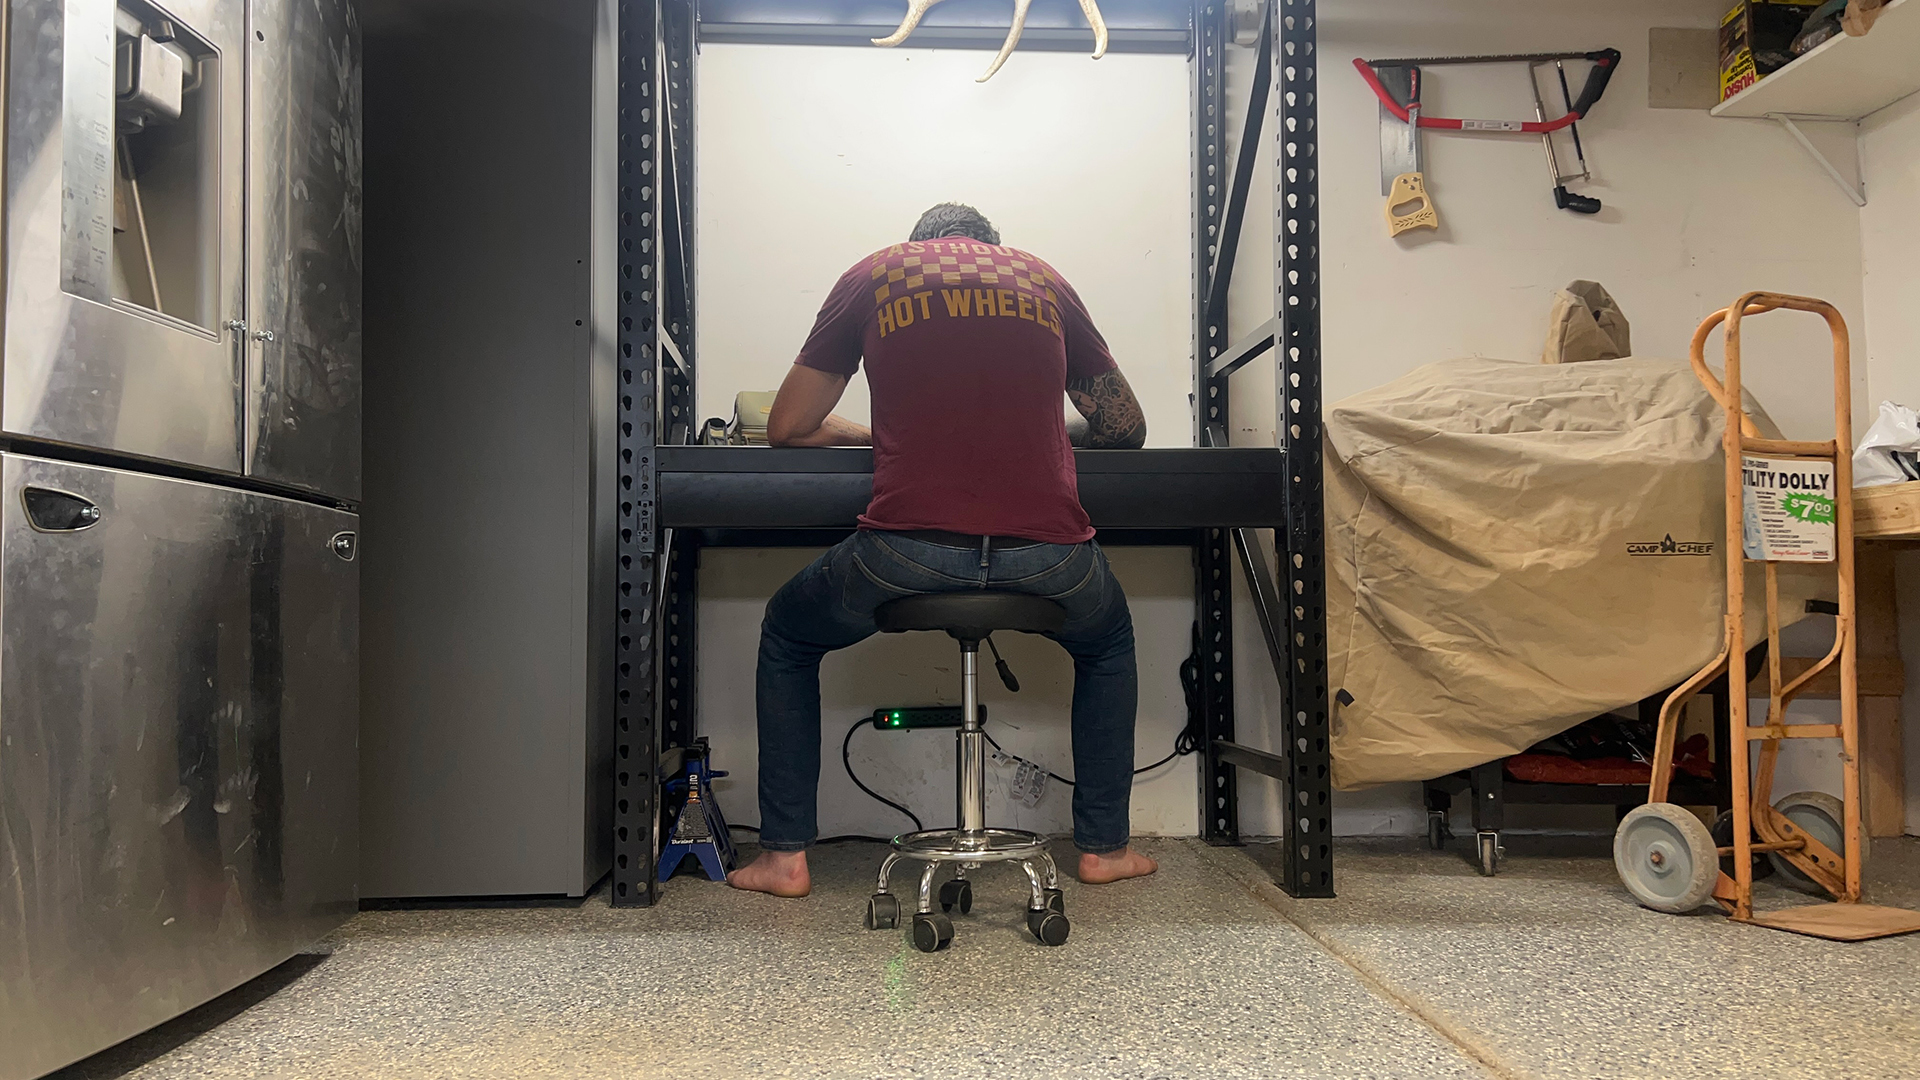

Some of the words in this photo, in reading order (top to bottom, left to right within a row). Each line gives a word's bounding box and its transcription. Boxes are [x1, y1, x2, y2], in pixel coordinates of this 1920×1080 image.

[1723, 70, 1756, 101] HUSKY
[877, 291, 933, 338] HOT
[941, 288, 1062, 335] WHEELS
[1742, 469, 1776, 489] TILITY
[1779, 473, 1830, 490] DOLLY
[1627, 545, 1659, 553] CAMP
[1677, 545, 1713, 553] CHEF
